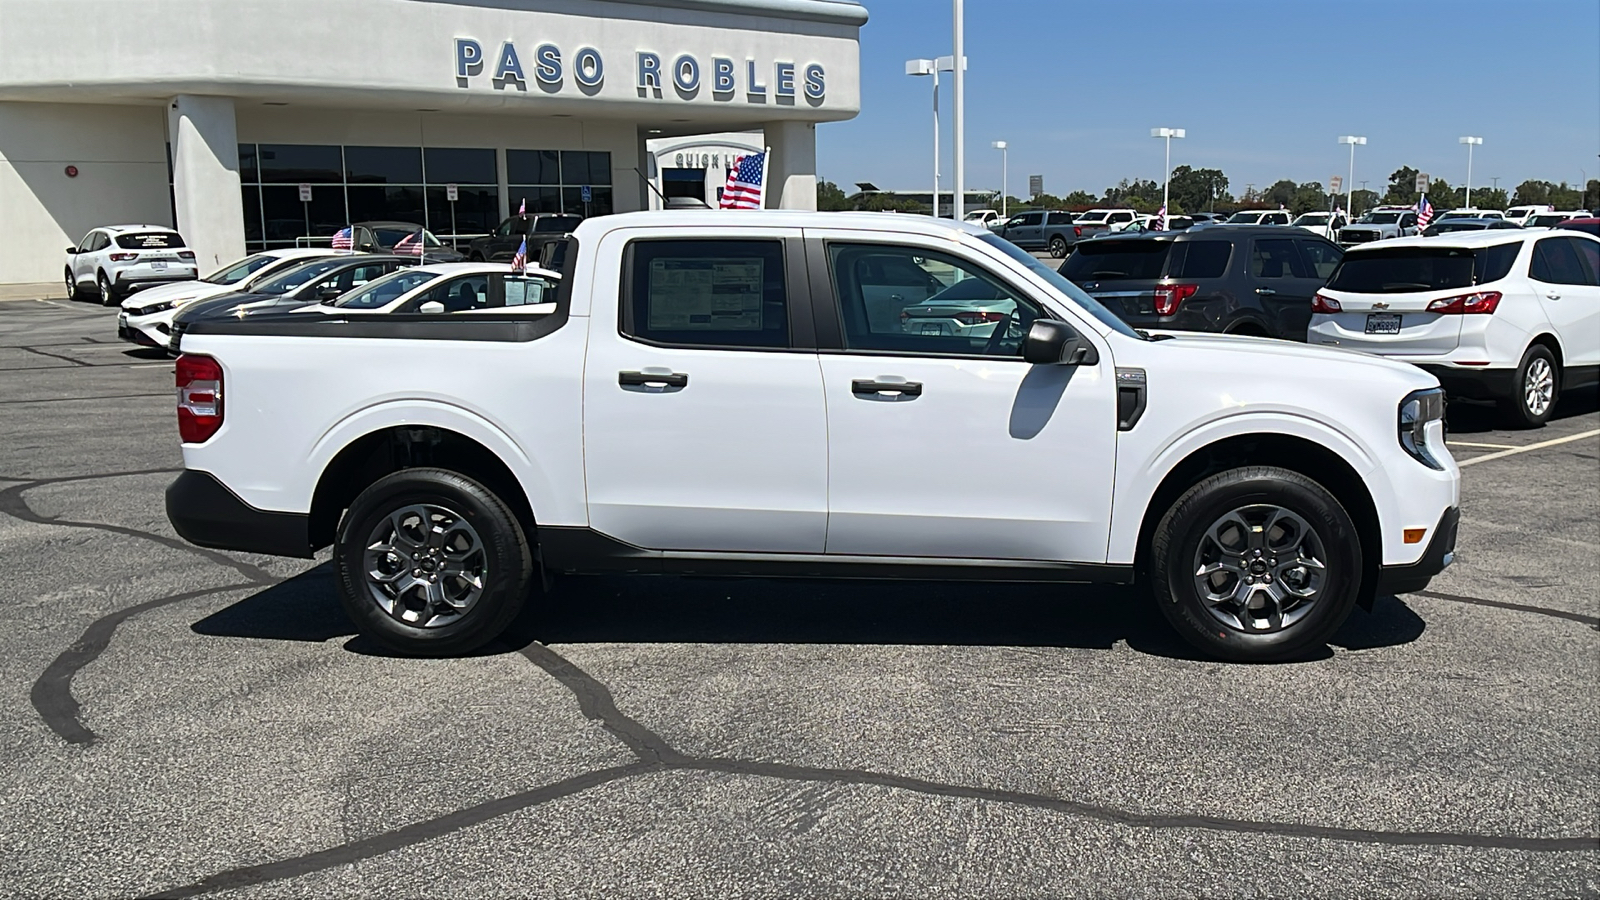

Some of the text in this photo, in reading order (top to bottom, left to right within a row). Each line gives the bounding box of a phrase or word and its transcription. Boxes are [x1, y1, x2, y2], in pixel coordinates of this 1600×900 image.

[454, 37, 825, 101] PASO ROBLES
[675, 153, 719, 165] QUICK
